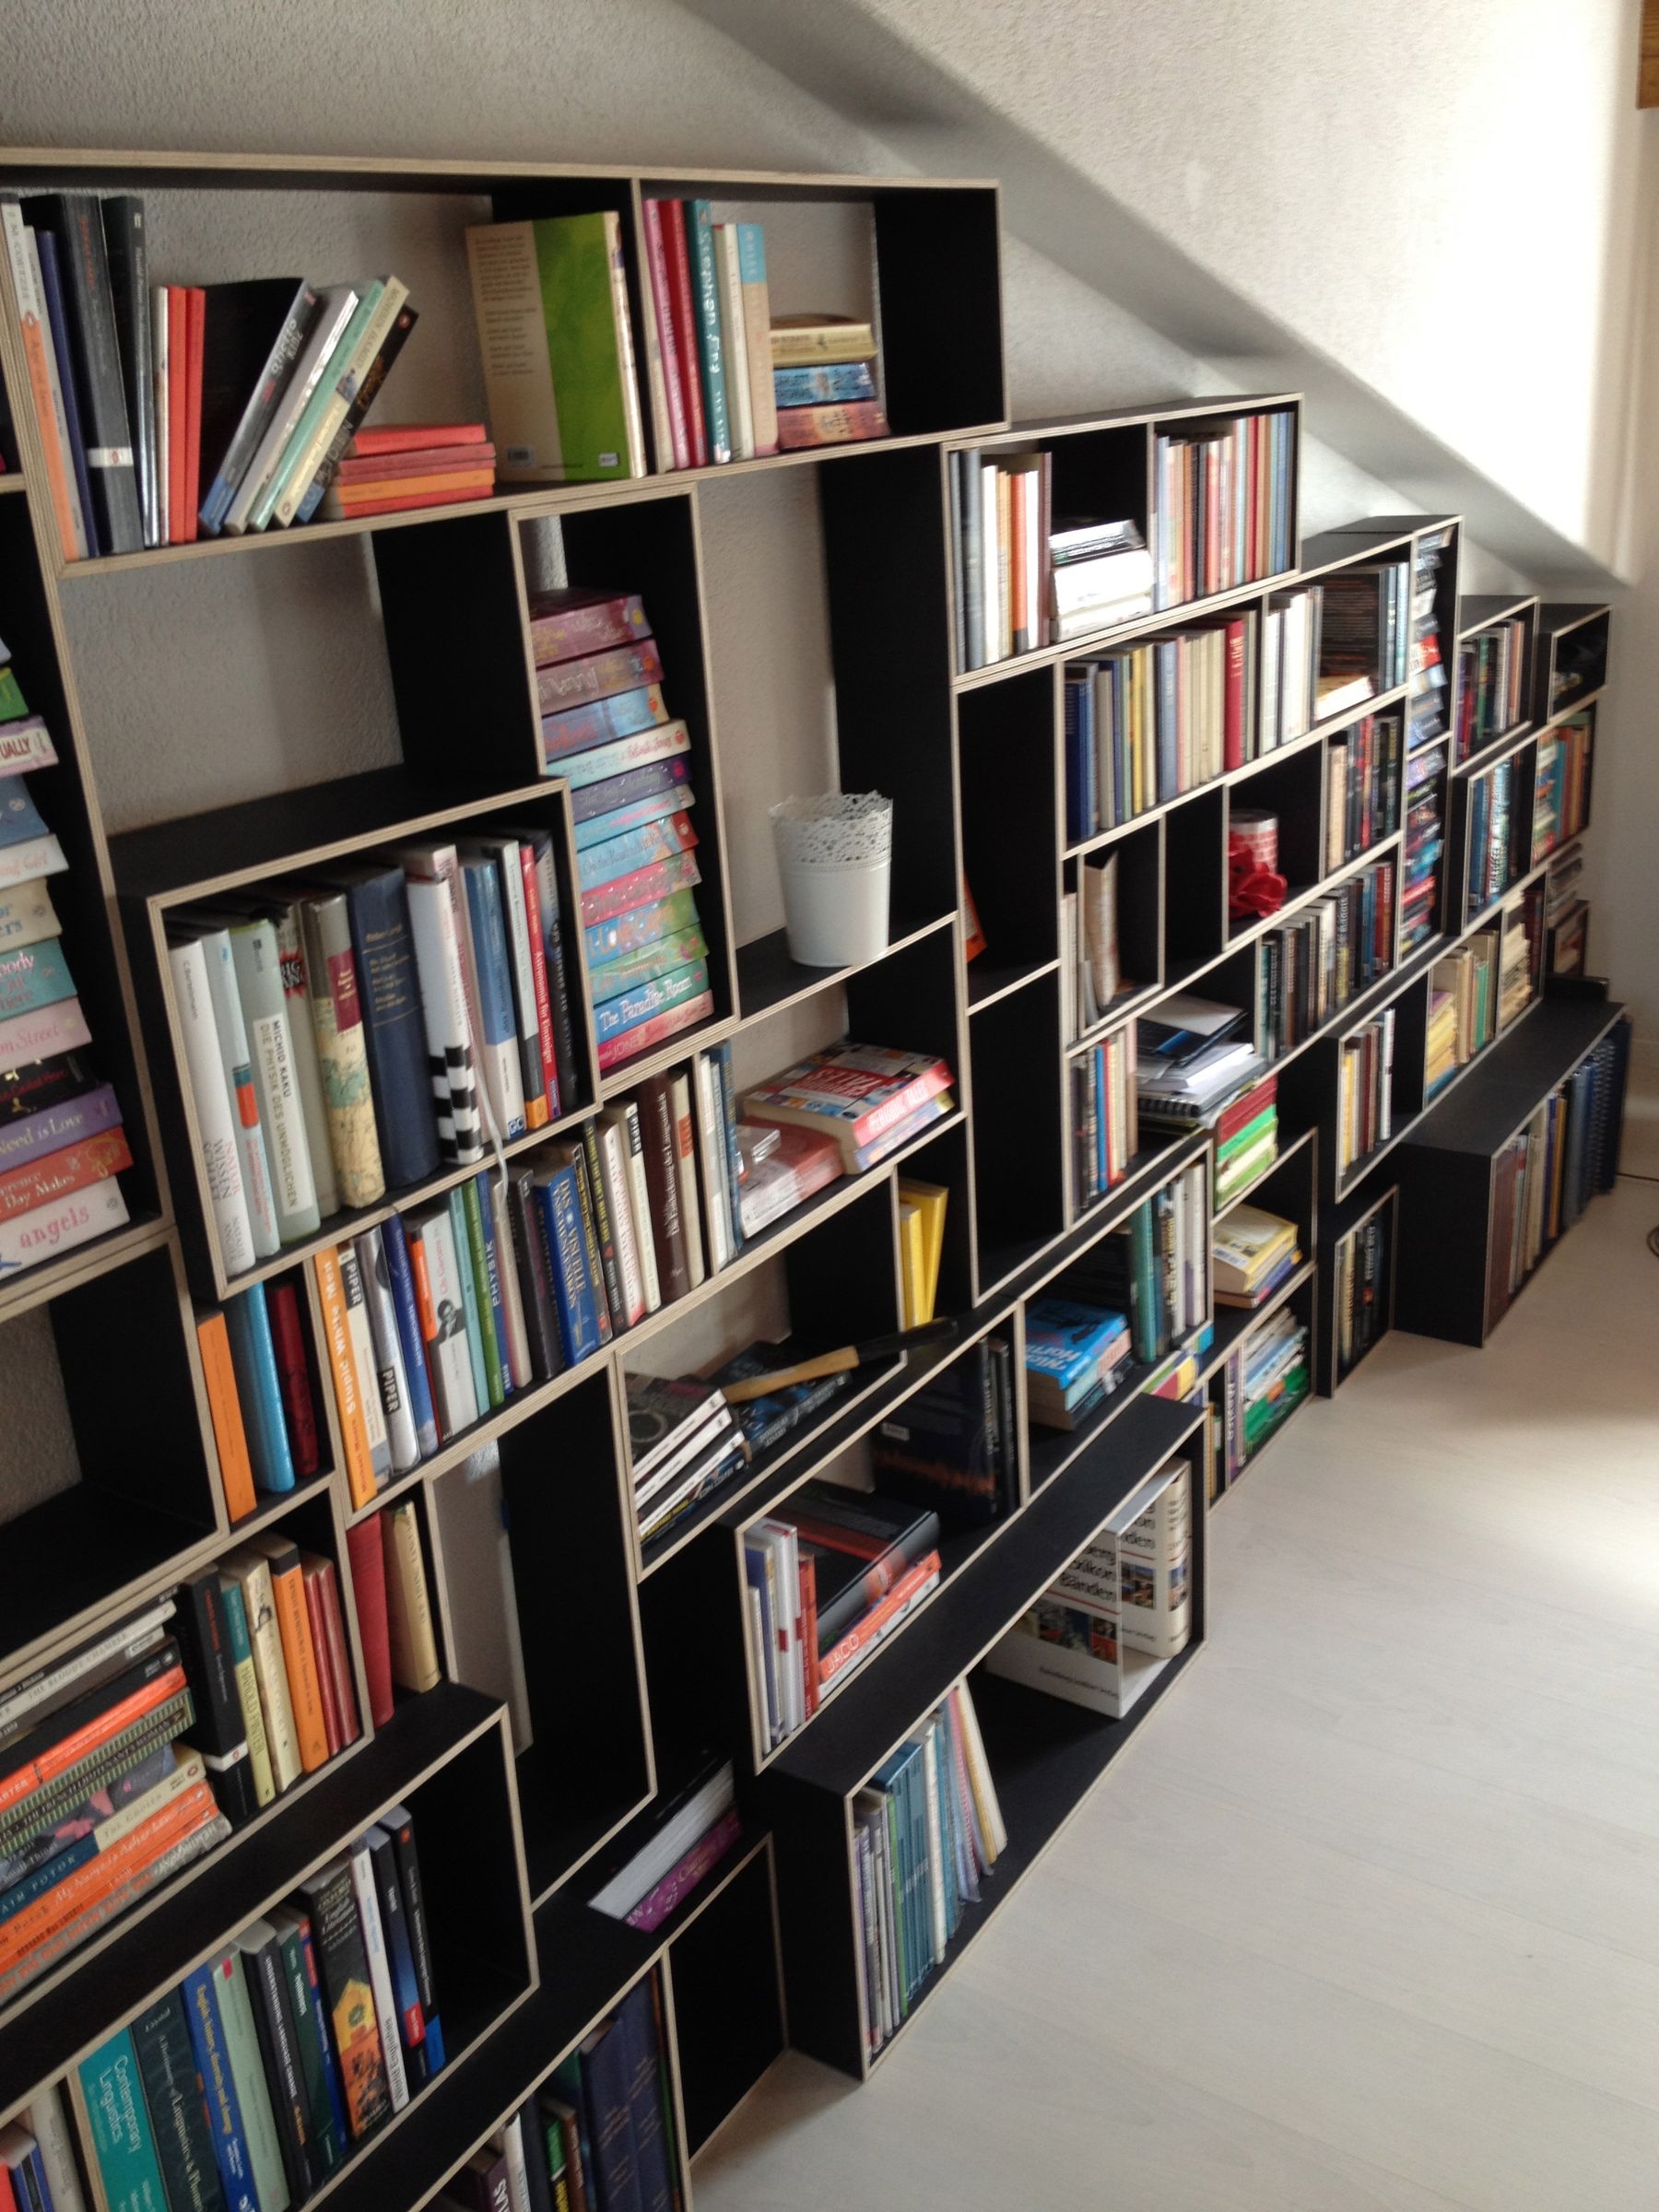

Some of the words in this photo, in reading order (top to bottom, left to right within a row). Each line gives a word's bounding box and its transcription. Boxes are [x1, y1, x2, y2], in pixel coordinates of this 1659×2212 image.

[700, 229, 717, 325] Stephen
[600, 1006, 619, 1031] The
[619, 982, 665, 1024] Paradise
[264, 1045, 278, 1092] PHYSIK
[278, 1065, 292, 1099] KAKU
[627, 1115, 641, 1154] PIPER
[19, 1203, 90, 1248] angels
[323, 1260, 335, 1301] Men
[346, 1262, 361, 1306] PIPER
[338, 1358, 357, 1417] Stupid
[381, 1371, 400, 1413] PIPER
[153, 1822, 219, 1874] HEMINGWAY
[31, 1854, 76, 1891] POTOK
[99, 2065, 124, 2146] Linguistics
[113, 2054, 143, 2155] Contemporary
